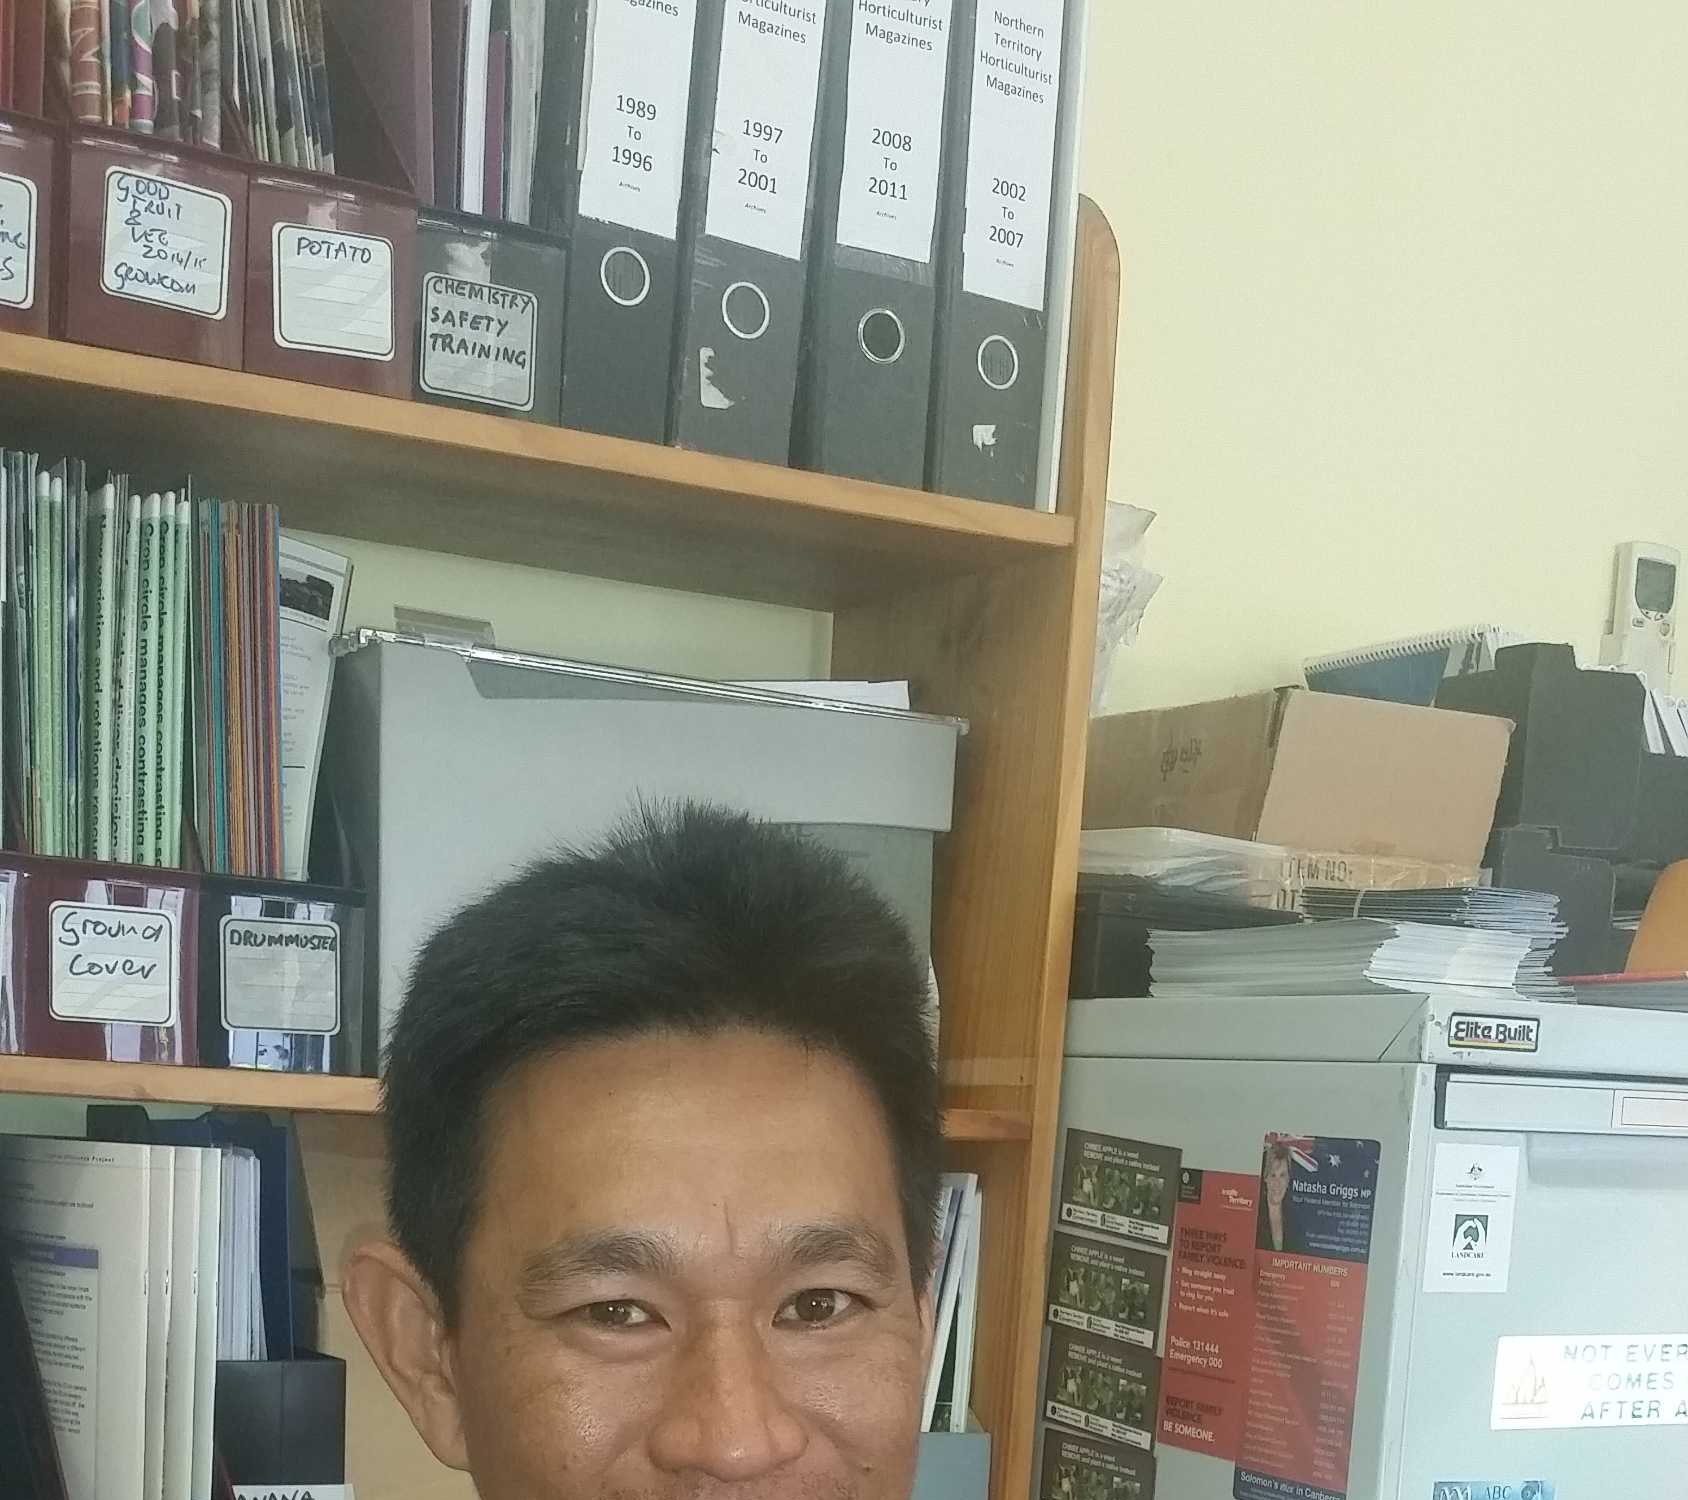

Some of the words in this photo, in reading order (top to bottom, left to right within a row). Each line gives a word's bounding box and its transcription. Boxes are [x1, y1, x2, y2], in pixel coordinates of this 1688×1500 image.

[625, 0, 680, 17] gazines
[739, 0, 817, 24] rticulturist
[858, 0, 944, 32] Horticulturist
[738, 10, 807, 45] Magazines
[865, 22, 934, 51] Magazines
[994, 10, 1045, 38] Northern
[994, 32, 1043, 62] Territory
[980, 50, 1053, 86] Horticulturist
[986, 74, 1045, 104] Magazines
[616, 94, 658, 121] 1989
[627, 125, 643, 141] To
[742, 119, 784, 145] 1997
[871, 128, 913, 152] 2008
[611, 145, 654, 172] 1996
[752, 149, 769, 164] To
[883, 157, 898, 171] To
[737, 168, 778, 195] 2001
[868, 176, 909, 201] 2011
[991, 177, 1027, 202] 2002
[124, 210, 142, 226] &
[1001, 206, 1015, 221] To
[988, 225, 1025, 249] 2007
[296, 236, 373, 264] POTATO
[432, 279, 532, 315] CHEMISTRY
[430, 306, 509, 338] SAFETY
[429, 333, 527, 370] TRAINING
[58, 910, 164, 947] Ground
[68, 953, 158, 980] Cover
[1453, 1020, 1493, 1042] Elite
[1495, 1023, 1534, 1043] Built
[1292, 1179, 1327, 1195] Natasha
[1329, 1183, 1359, 1200] Griggs
[1170, 1335, 1191, 1349] Police
[1563, 1344, 1612, 1364] NOT
[1626, 1343, 1688, 1363] EVER
[1169, 1348, 1207, 1368] Emergency
[1588, 1371, 1675, 1391] COMES
[1580, 1400, 1662, 1420] AFTER
[1163, 1420, 1174, 1433] BE
[1486, 1485, 1512, 1500] ABC
